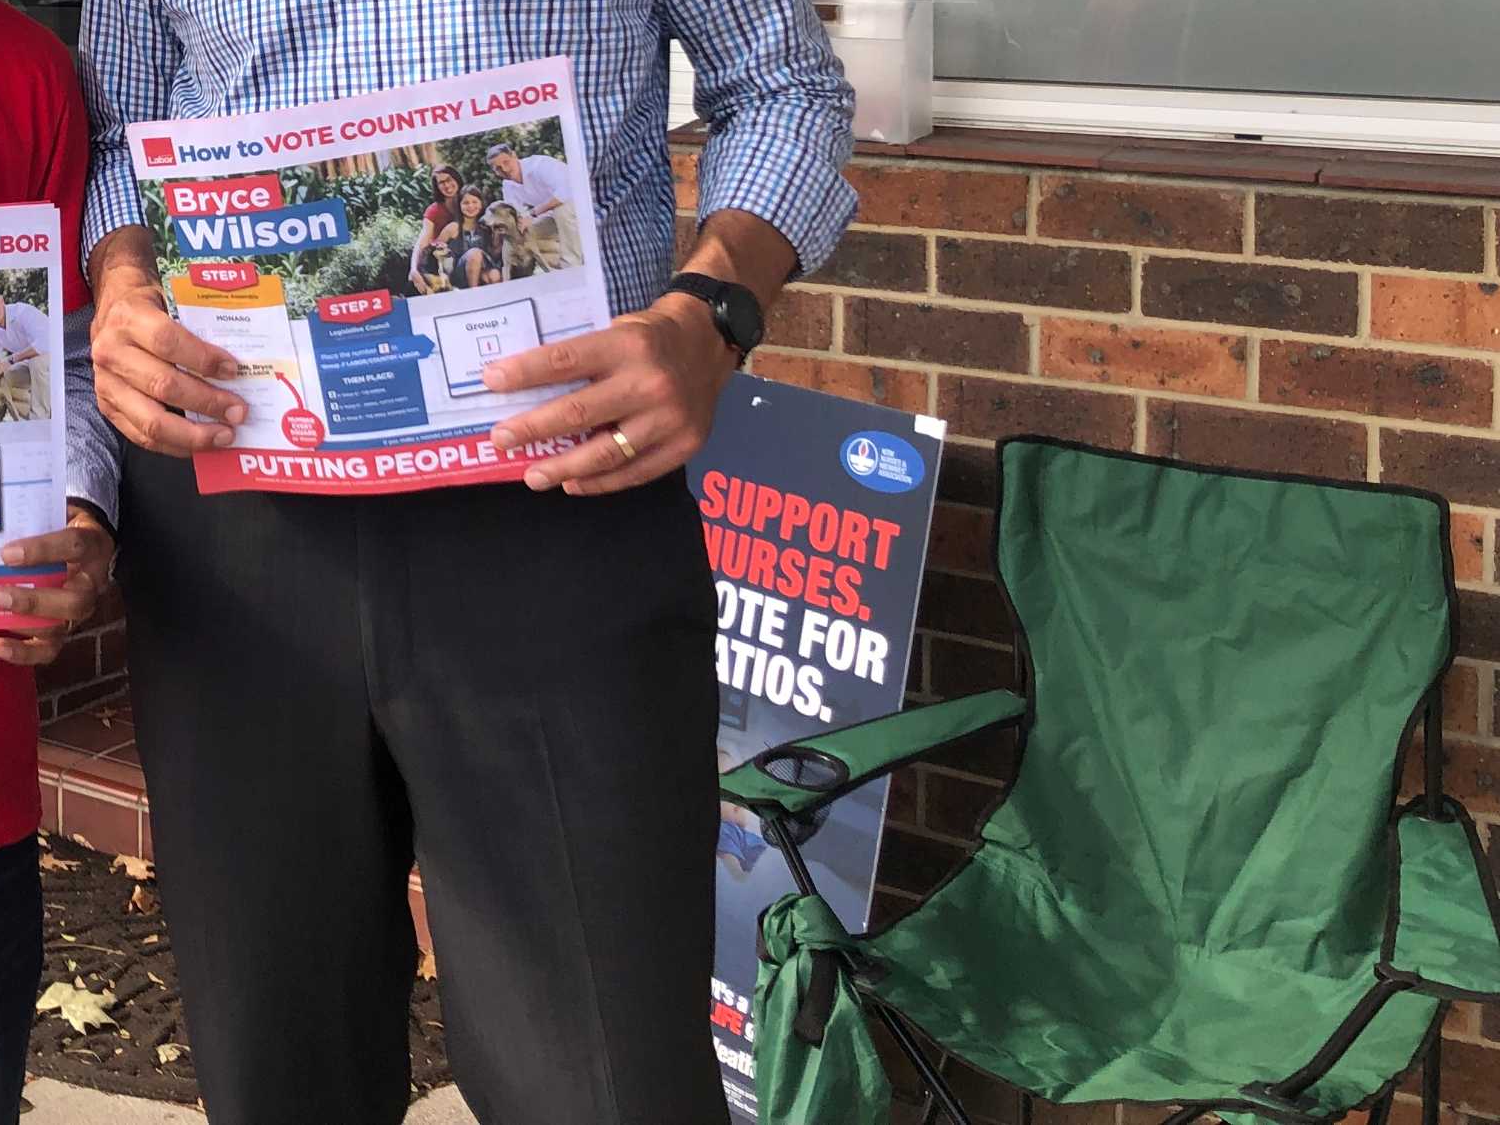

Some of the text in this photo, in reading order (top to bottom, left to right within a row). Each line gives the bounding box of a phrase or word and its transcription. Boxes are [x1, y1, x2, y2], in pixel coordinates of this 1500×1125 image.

[178, 82, 559, 163] How to VOTE COUNTRY LABOR
[148, 155, 174, 165] Labor
[172, 186, 271, 216] Bryce
[178, 211, 339, 251] Wilson
[201, 269, 238, 281] STEP
[329, 297, 382, 316] STEP 2
[465, 319, 499, 332] Group
[239, 453, 368, 479] PUTTING
[375, 440, 498, 476] PEOPLE
[700, 470, 901, 571] SUPPORT
[703, 521, 872, 622] NURSES.
[714, 580, 889, 685] OTE FOR
[715, 633, 832, 724] ATIOS.
